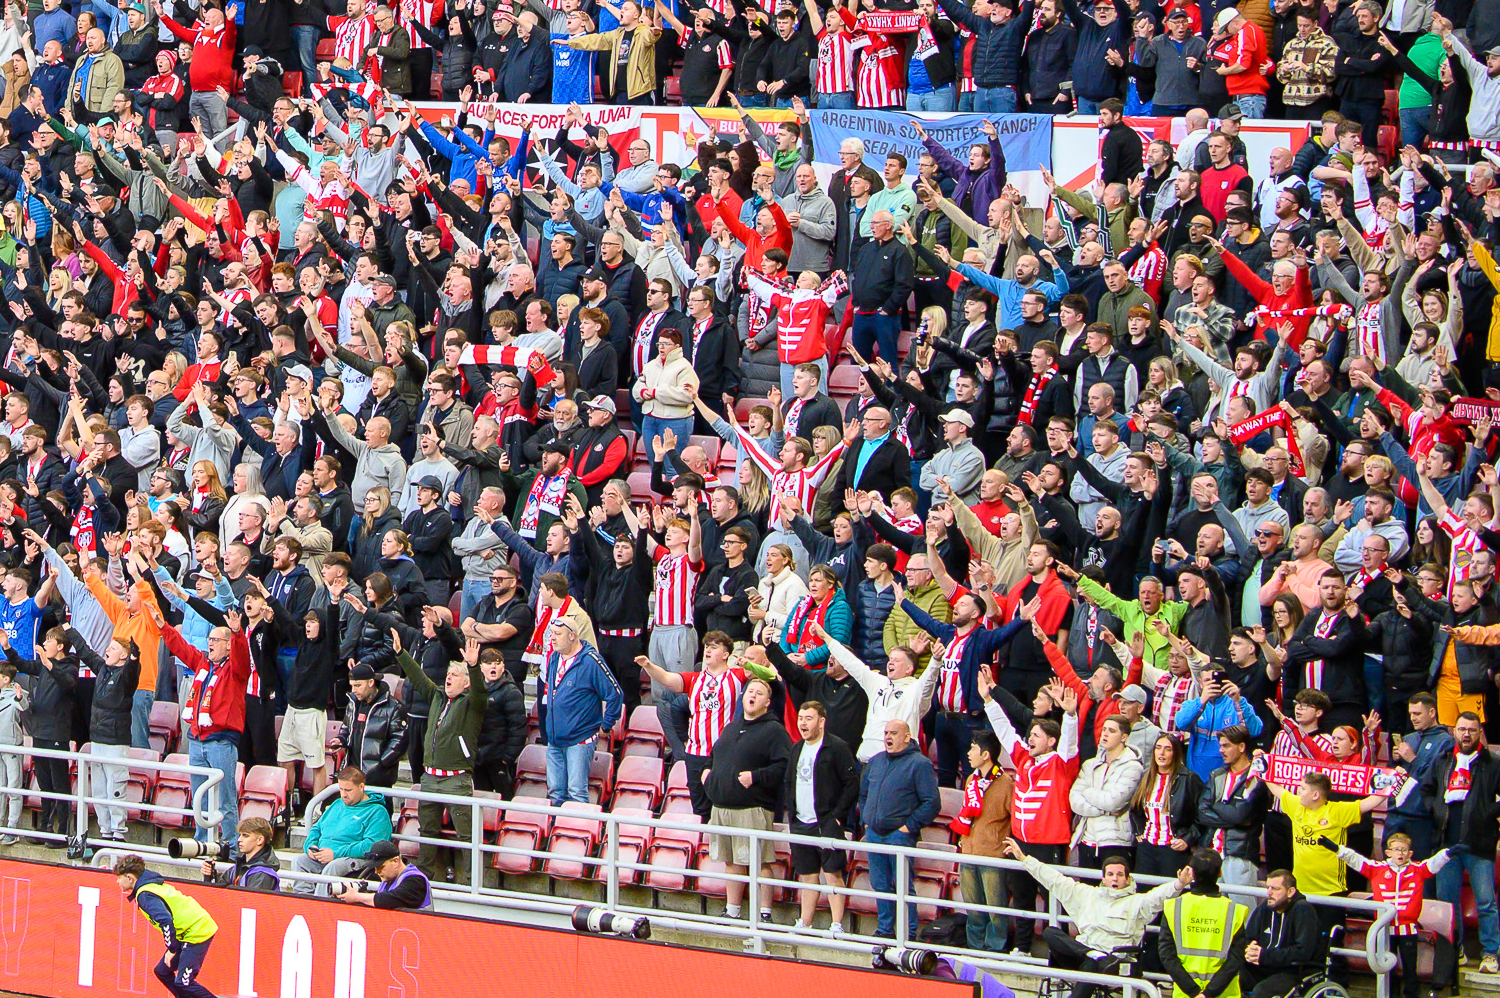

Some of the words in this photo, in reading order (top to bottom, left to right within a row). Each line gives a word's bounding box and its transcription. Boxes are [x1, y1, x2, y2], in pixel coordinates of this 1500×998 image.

[466, 105, 531, 128] AUACES
[593, 106, 632, 123] JUVAT
[821, 111, 896, 135] ARGENTINA
[1266, 411, 1282, 425] THE
[1274, 761, 1316, 780] ROBIN
[1190, 916, 1219, 925] SAFETY
[1186, 925, 1221, 935] STEWARD
